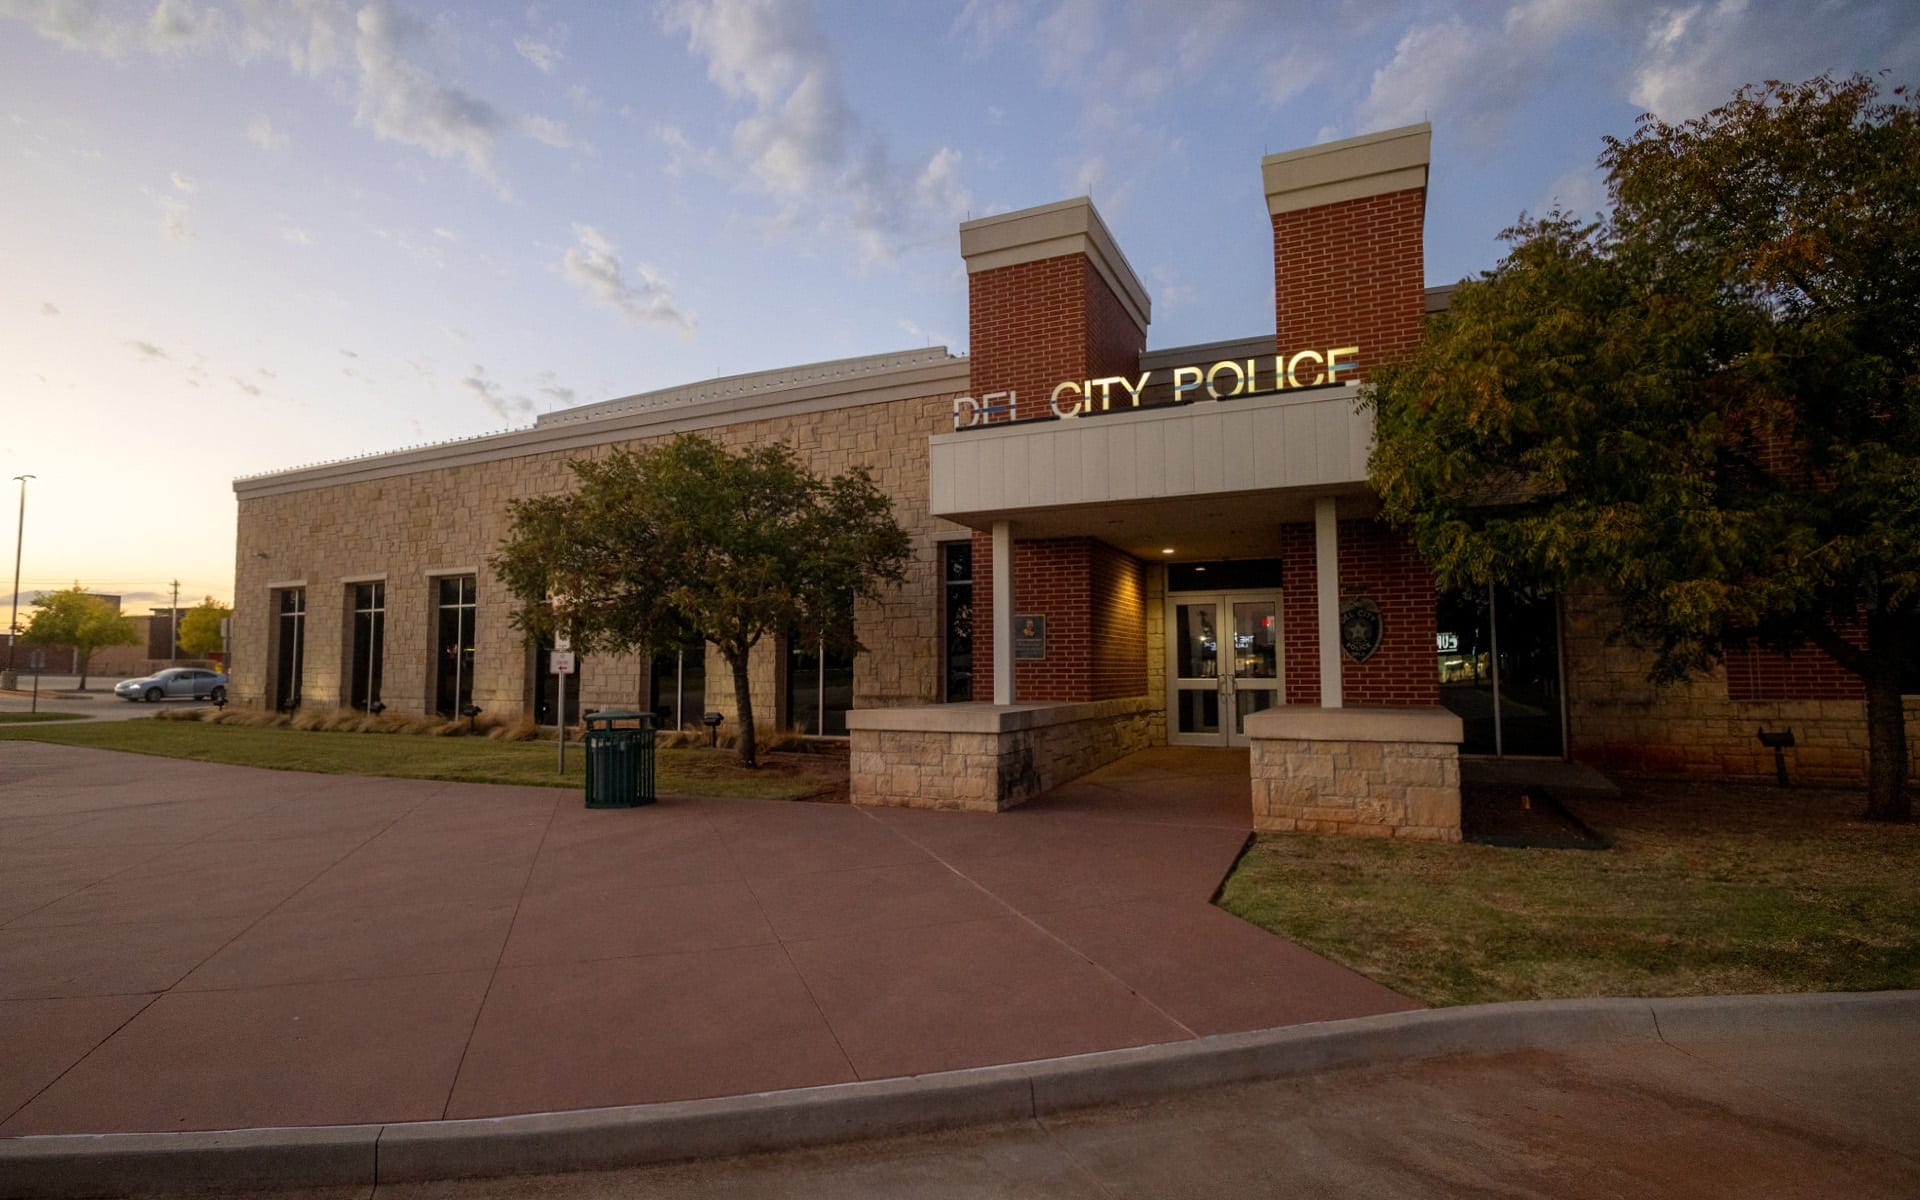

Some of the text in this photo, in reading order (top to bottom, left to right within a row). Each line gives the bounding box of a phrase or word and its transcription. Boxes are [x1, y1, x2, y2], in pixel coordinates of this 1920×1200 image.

[953, 346, 1360, 433] DEL CITY POLICE
